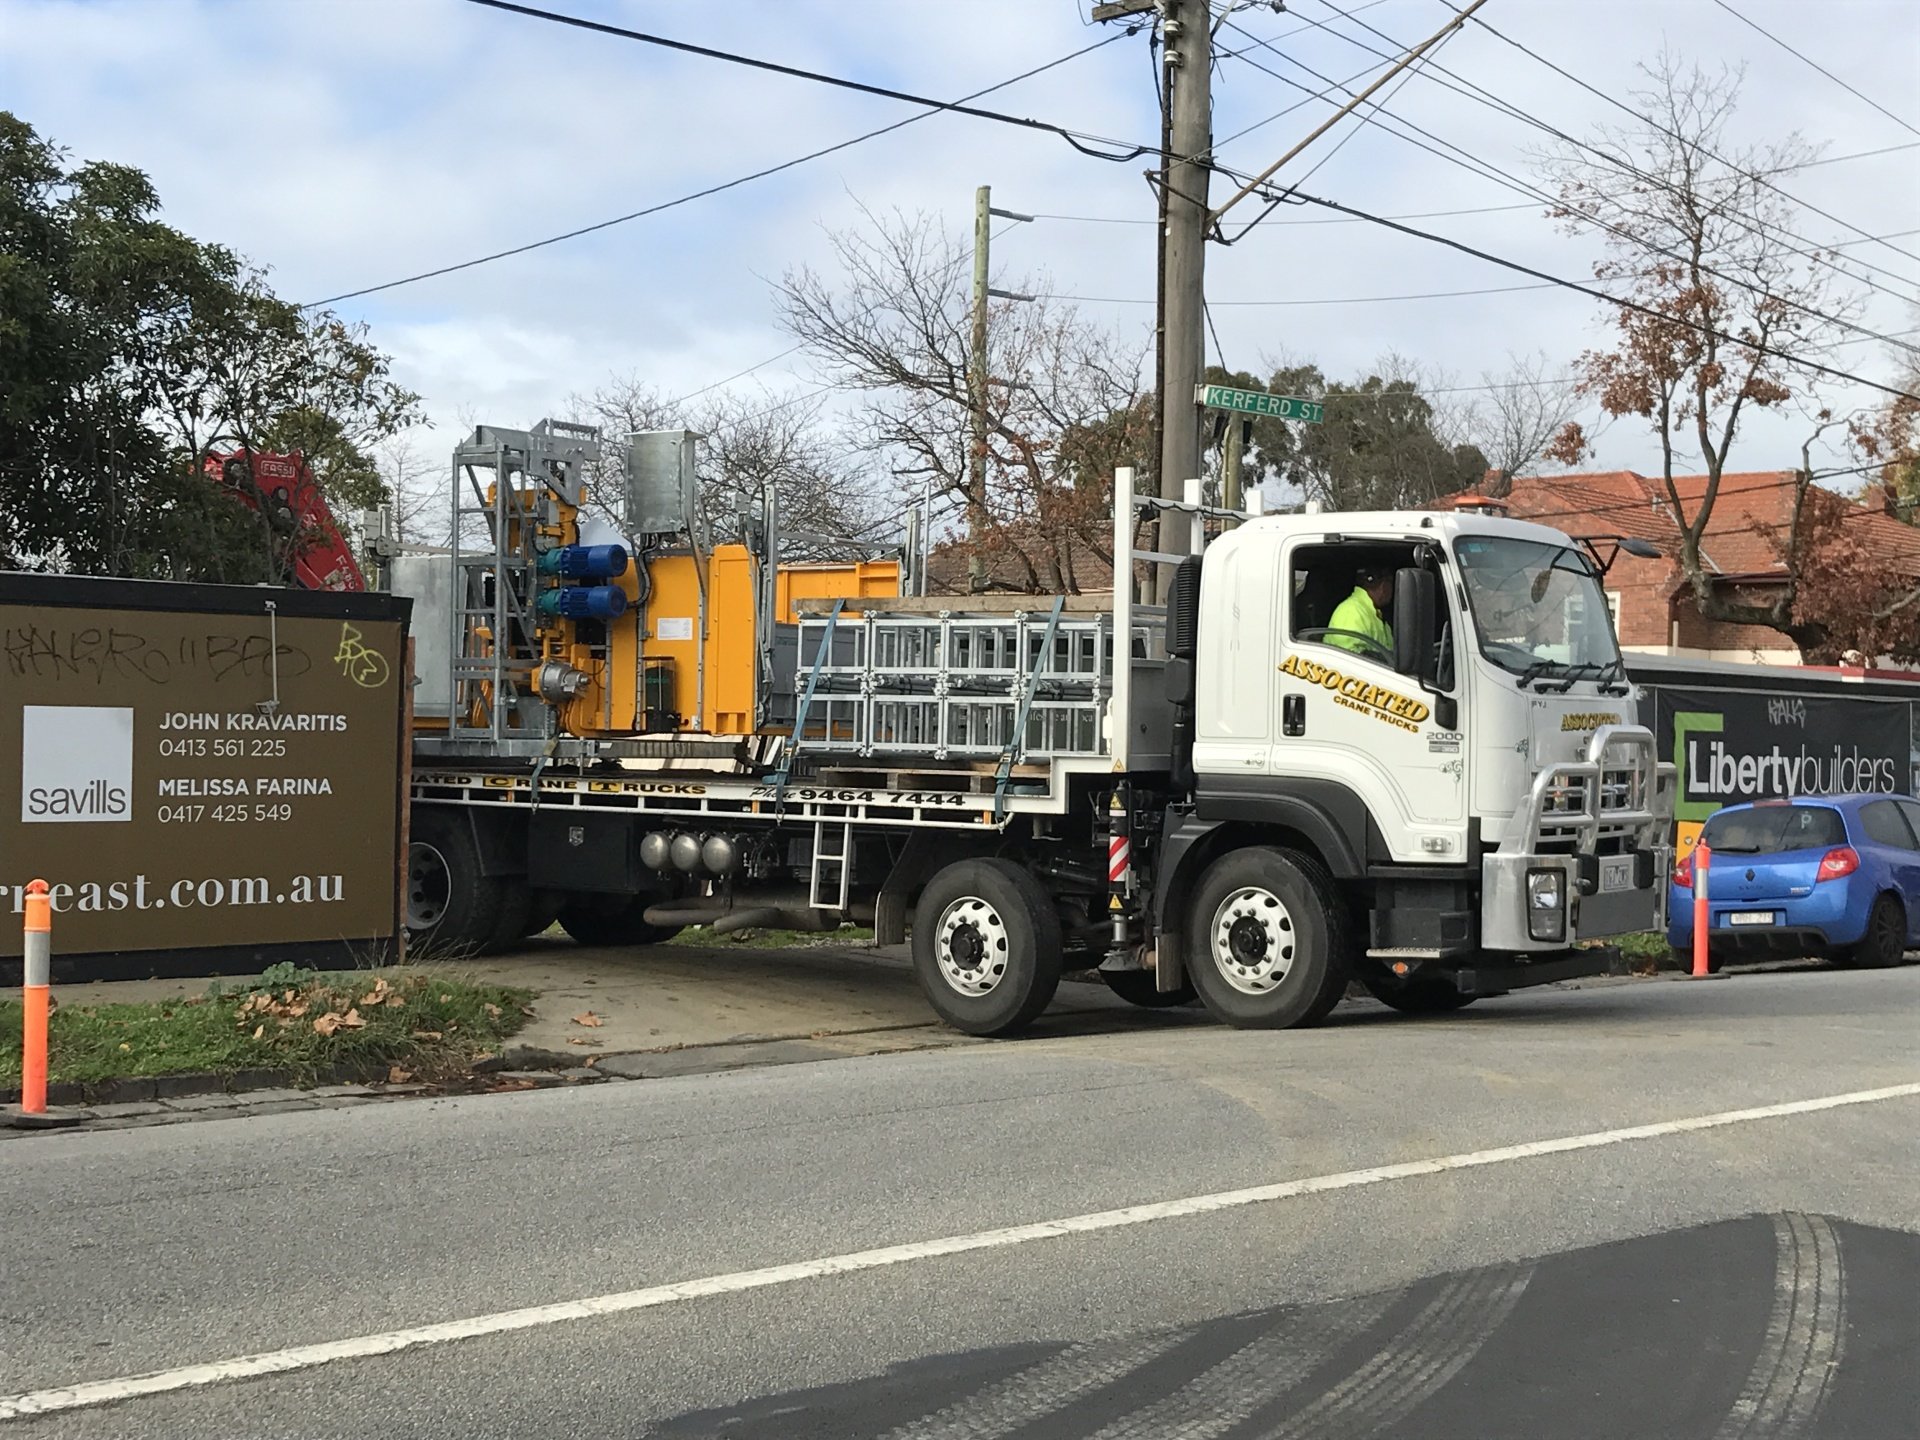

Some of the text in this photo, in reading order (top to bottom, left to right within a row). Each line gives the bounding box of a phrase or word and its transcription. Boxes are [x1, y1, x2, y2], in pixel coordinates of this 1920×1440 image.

[1209, 388, 1323, 421] KERFERD ST
[1278, 654, 1430, 723] ASSOCIATED
[159, 712, 348, 731] JOHN KRAVARITIS
[1333, 694, 1420, 734] CRANE TRUCKS
[1426, 731, 1464, 741] 2000
[159, 739, 286, 757] 0413 561 225
[158, 778, 333, 796] MELISSA FARINA
[28, 779, 127, 815] savills
[800, 789, 876, 802] 9464
[886, 792, 966, 806] 7444
[158, 803, 292, 823] 0417 425 549
